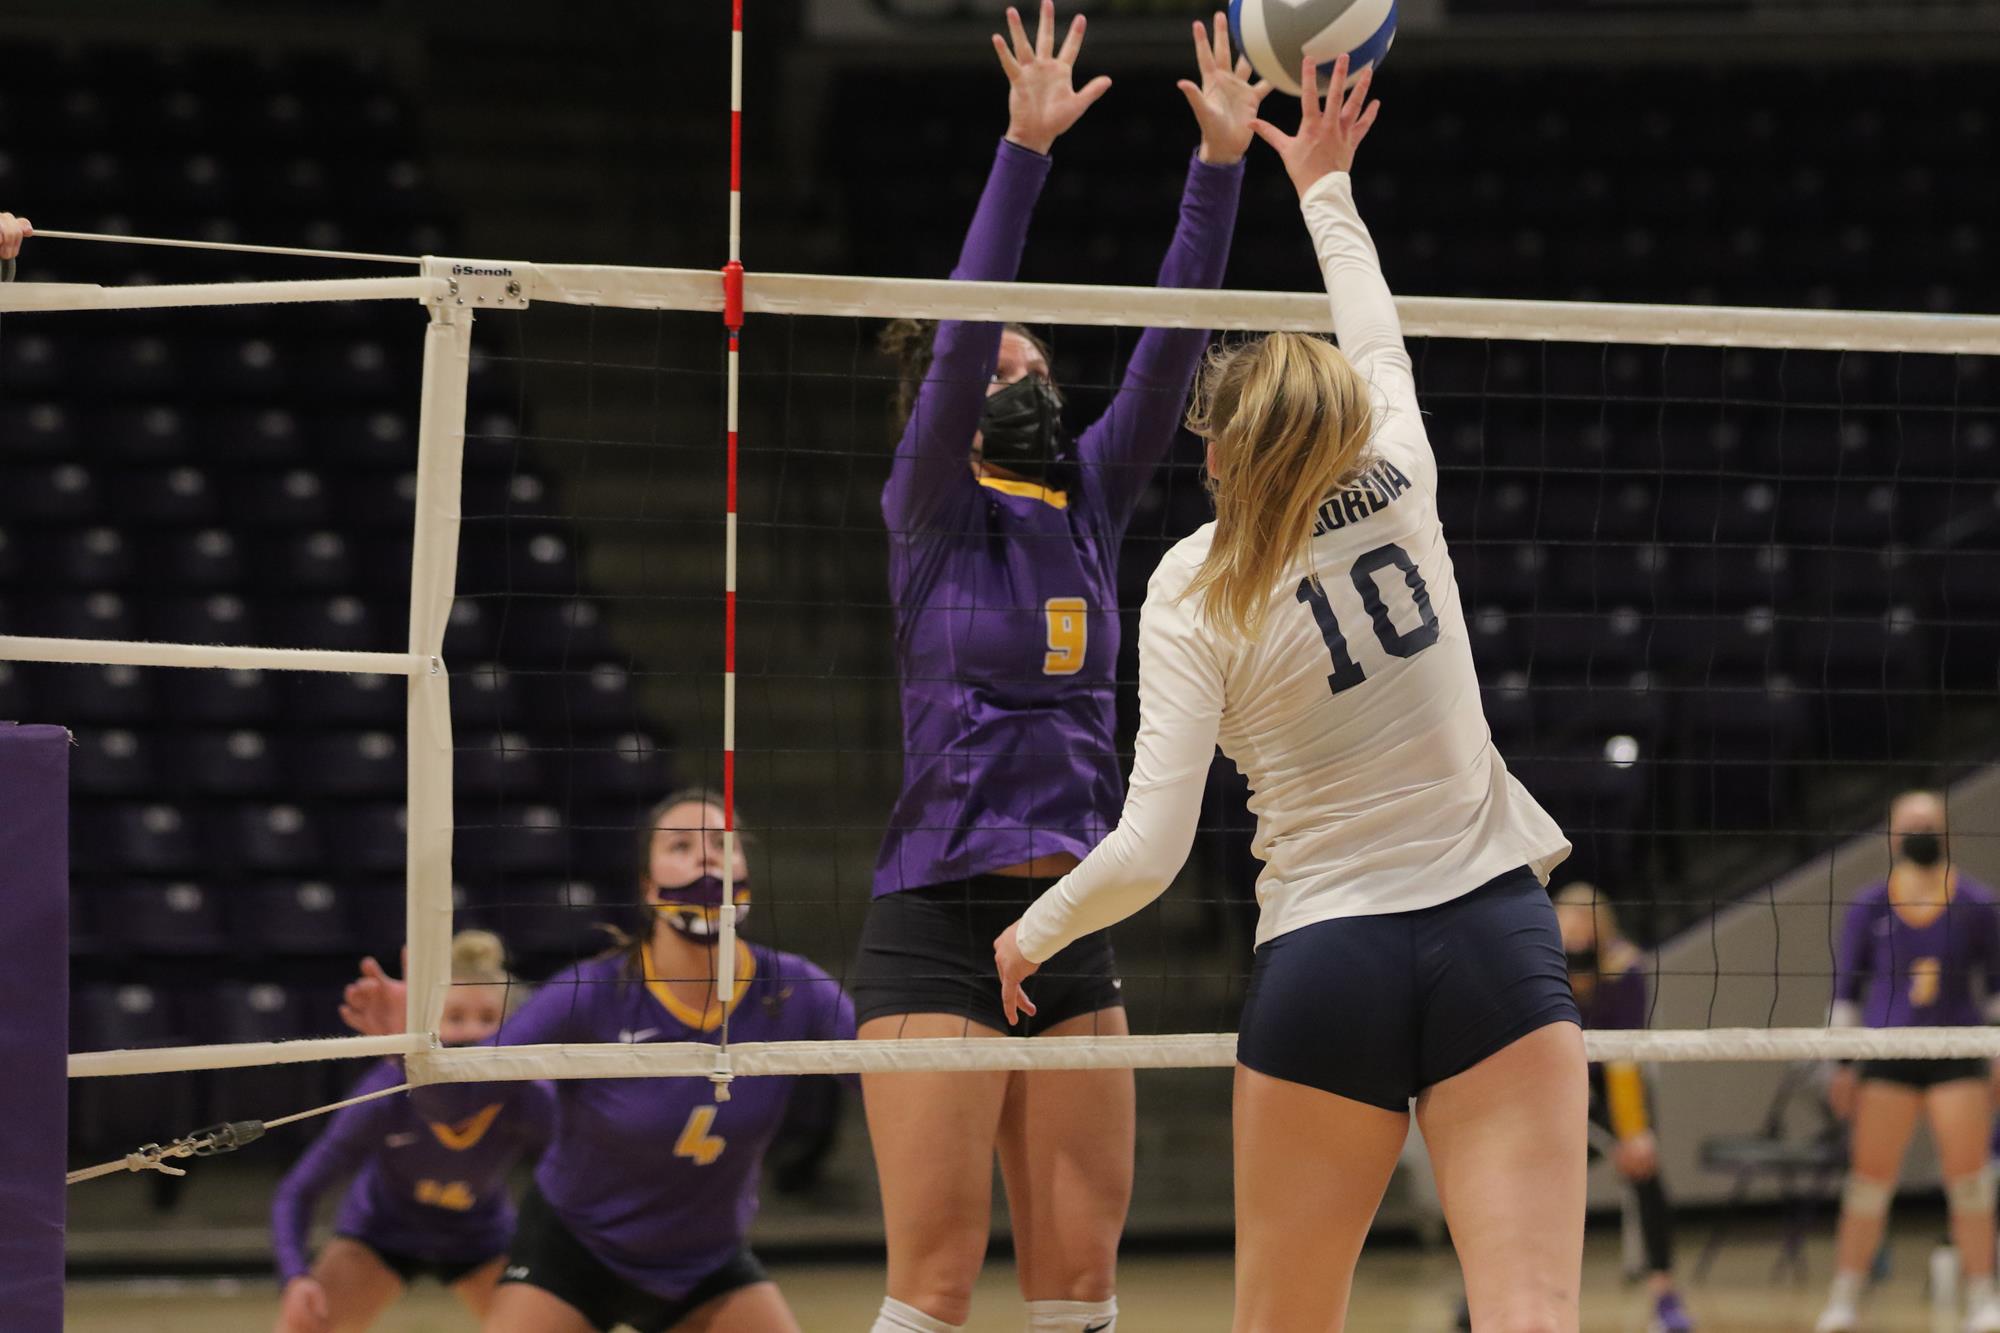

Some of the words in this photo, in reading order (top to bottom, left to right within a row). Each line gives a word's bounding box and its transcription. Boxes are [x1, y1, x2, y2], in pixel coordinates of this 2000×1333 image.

[463, 265, 513, 277] Senoh
[1042, 597, 1088, 676] 9
[1295, 542, 1440, 695] 10
[672, 1105, 727, 1167] 4
